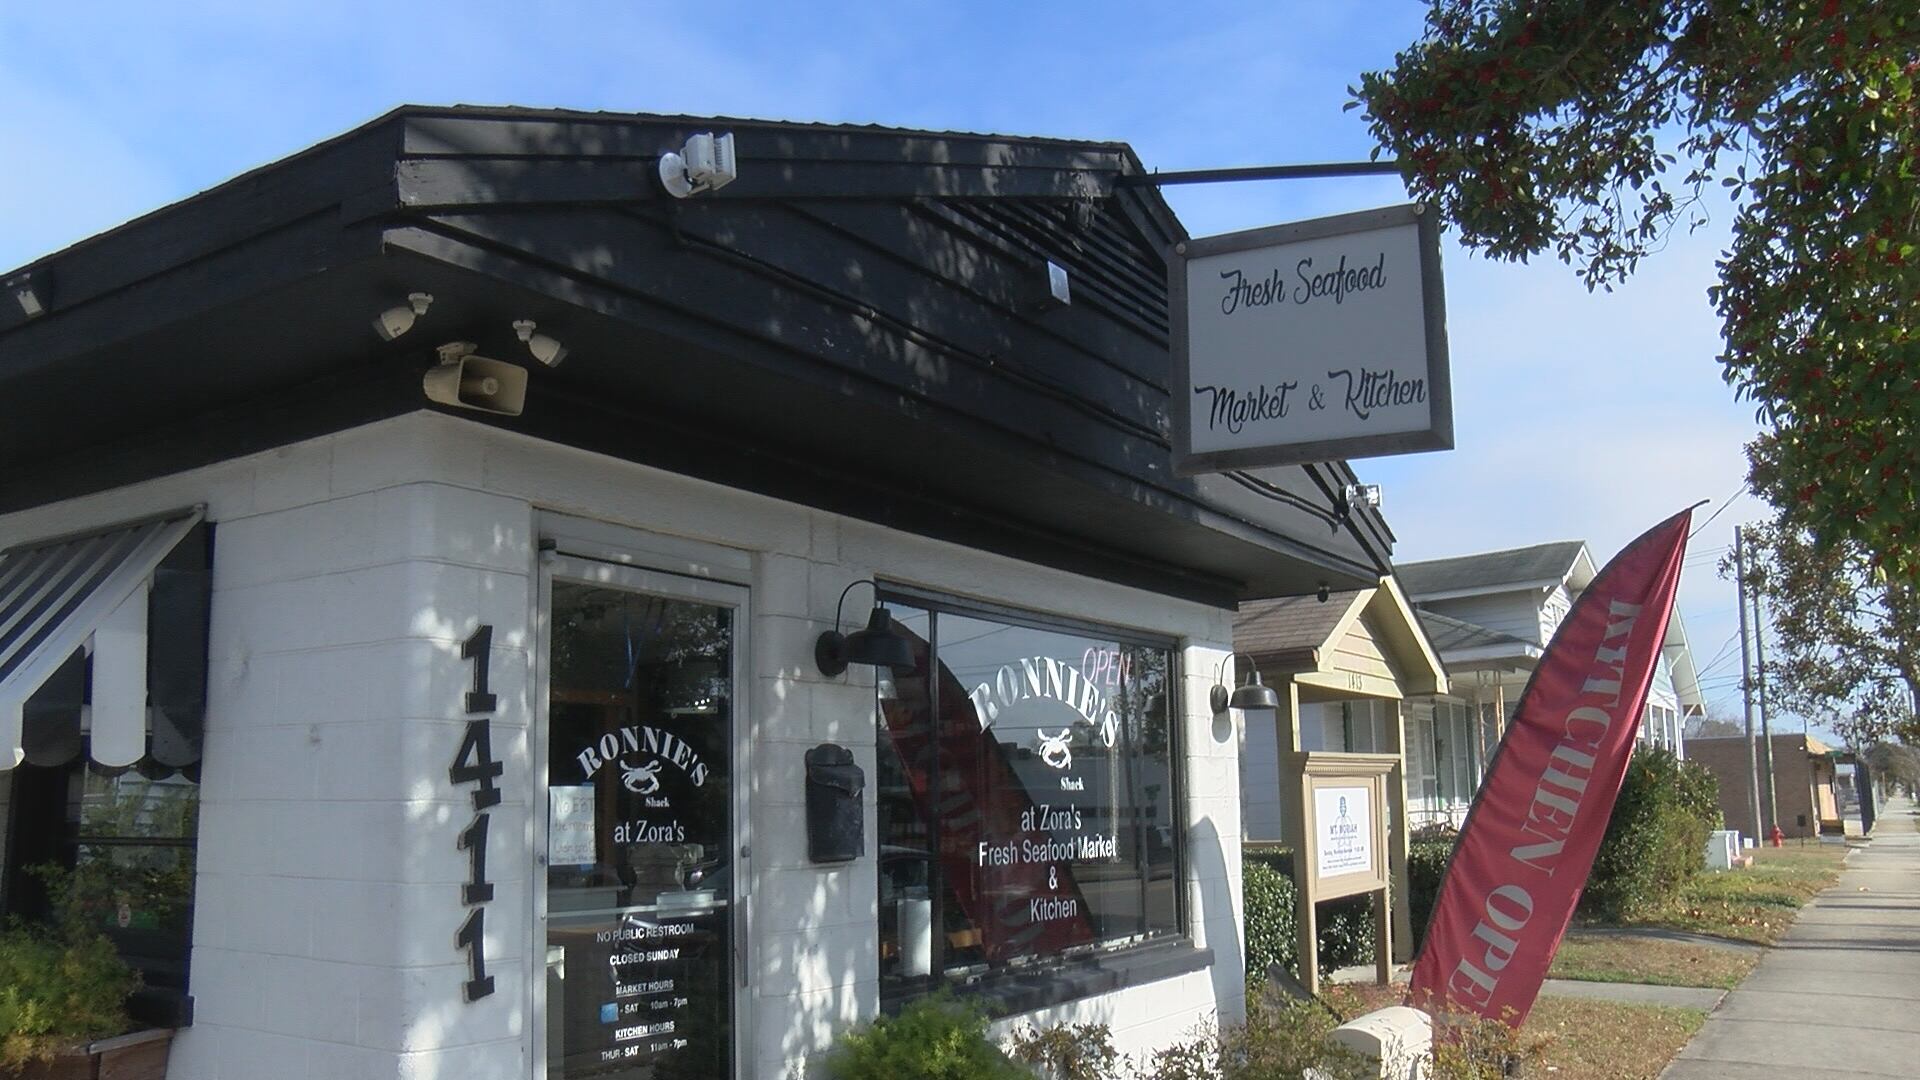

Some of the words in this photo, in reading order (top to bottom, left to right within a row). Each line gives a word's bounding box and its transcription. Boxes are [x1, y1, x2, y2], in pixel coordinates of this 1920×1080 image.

[1220, 268, 1286, 315] Fresh
[1293, 252, 1387, 305] Seafood
[1194, 380, 1298, 434] Market
[1308, 383, 1326, 411] &
[1327, 367, 1427, 421] Kitchen
[1082, 647, 1132, 686] OPEN
[968, 655, 1119, 748] RONNIE'S
[1510, 598, 1643, 878] KITCHEN
[576, 725, 710, 788] RONNIE'S
[1060, 776, 1085, 791] Shack
[449, 624, 504, 1003] 1411
[645, 797, 670, 808] Shack
[614, 818, 631, 843] at
[636, 820, 685, 843] Zora's
[1021, 807, 1036, 832] at
[1039, 804, 1082, 830] Zora's
[979, 841, 1018, 867] Fresh
[1022, 837, 1074, 863] Seafood
[1077, 833, 1117, 859] Market
[1048, 865, 1058, 889] &
[1030, 898, 1077, 922] Kitchen
[597, 931, 611, 943] NO
[612, 927, 645, 941] PUBLIC
[646, 923, 694, 937] RESTROOM
[609, 952, 645, 966] CLOSED
[646, 948, 680, 962] SUNDAY
[1446, 883, 1534, 1009] OPE
[616, 983, 647, 996] MARKET
[648, 979, 674, 991] HOURS
[624, 1003, 639, 1014] SAT
[673, 998, 688, 1008] 7pm
[615, 1025, 648, 1039] KITCHEN
[649, 1020, 675, 1033] HOURS
[624, 1045, 639, 1057] SAT
[673, 1039, 688, 1049] 7pm
